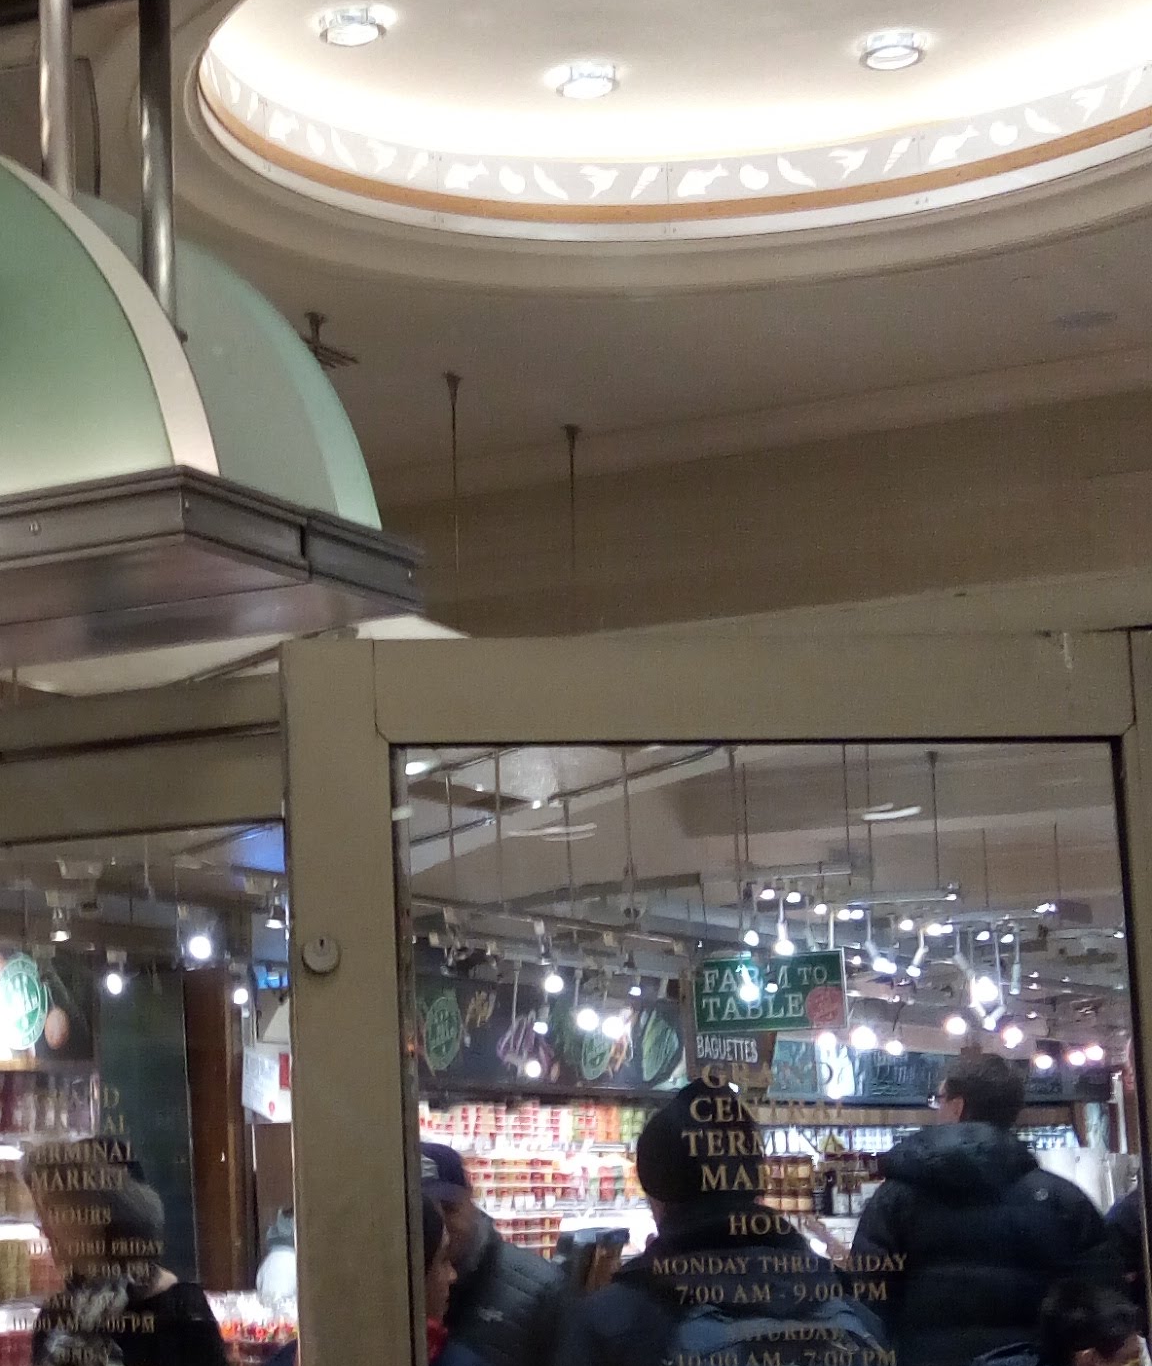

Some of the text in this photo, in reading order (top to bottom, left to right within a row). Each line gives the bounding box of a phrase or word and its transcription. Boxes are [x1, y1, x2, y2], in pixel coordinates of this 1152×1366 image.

[797, 966, 828, 986] TO
[702, 993, 805, 1022] TABLE
[696, 1032, 759, 1064] BAGUETTES
[652, 1256, 751, 1276] MONDAY
[758, 1254, 820, 1274] THRU
[732, 1283, 772, 1304] AM
[853, 1280, 888, 1302] PM
